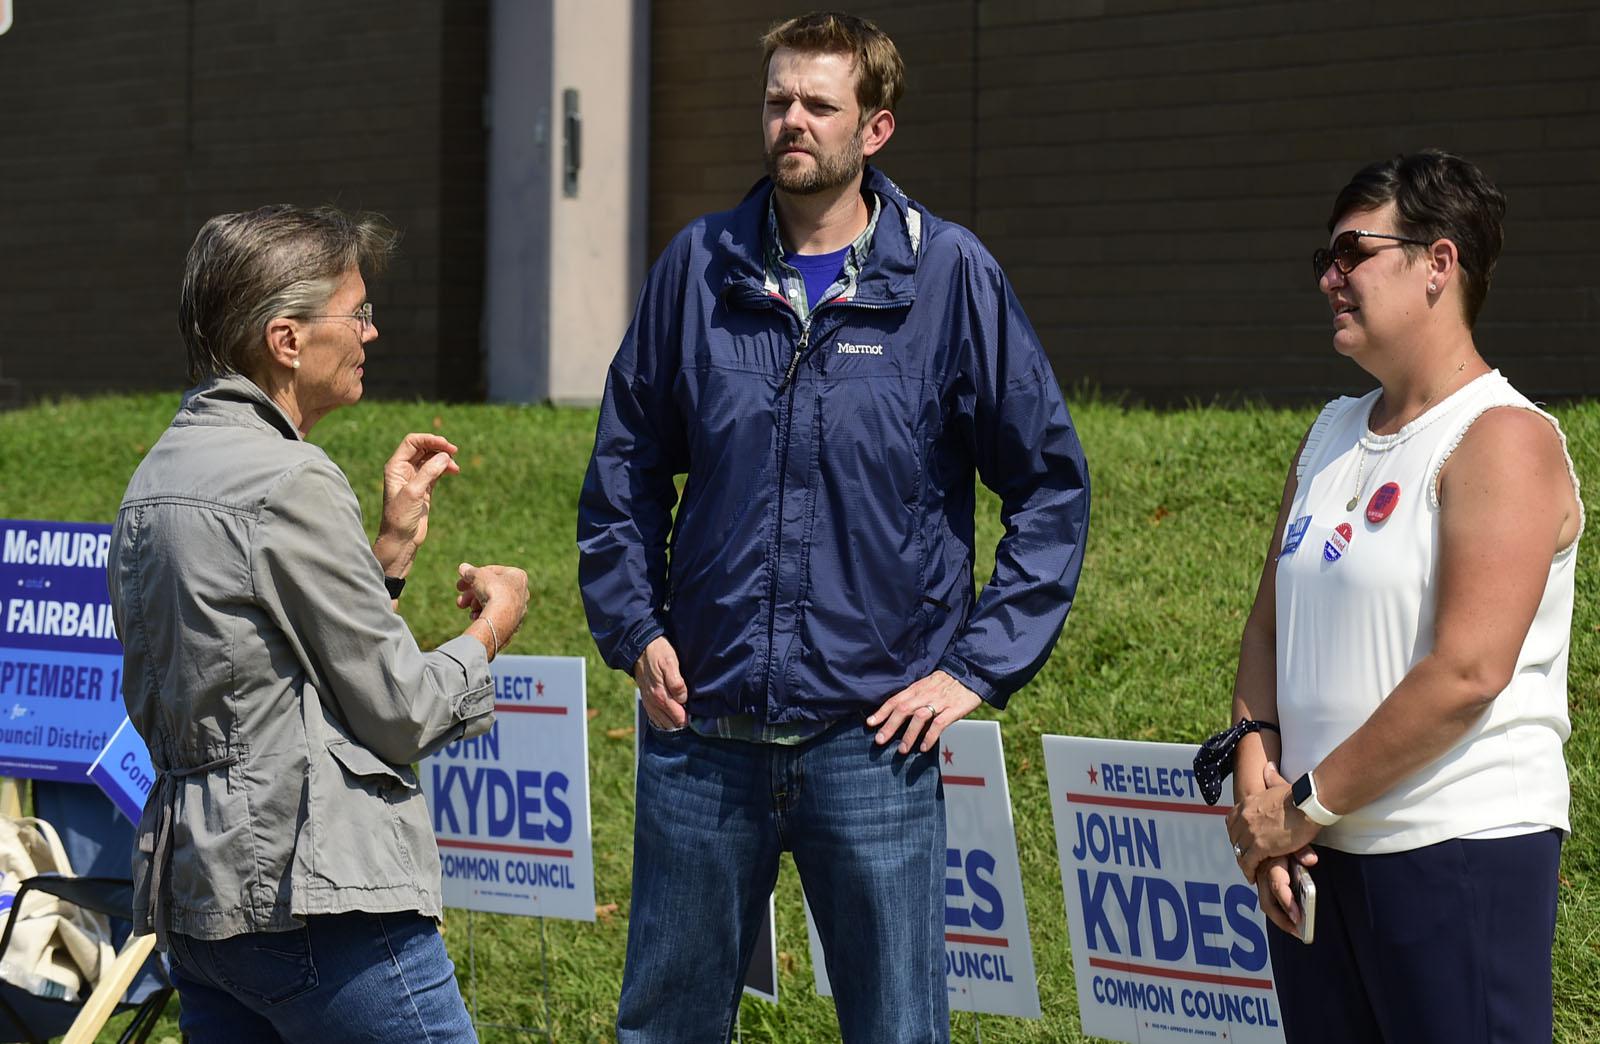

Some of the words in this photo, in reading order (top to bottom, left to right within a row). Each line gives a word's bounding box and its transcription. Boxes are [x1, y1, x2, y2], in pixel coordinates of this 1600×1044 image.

[837, 342, 883, 355] Marmot
[0, 660, 103, 701] PTEMBER
[110, 667, 123, 702] 1
[10, 704, 27, 720] for
[47, 727, 108, 751] District
[432, 764, 573, 844] KYDES
[1072, 811, 1161, 870] JOHN
[439, 854, 500, 882] OMMON
[505, 860, 575, 889] COUNCIL
[1077, 867, 1268, 972] KYDES
[1093, 975, 1175, 1015] COMMON
[1181, 988, 1279, 1028] COUNCIL
